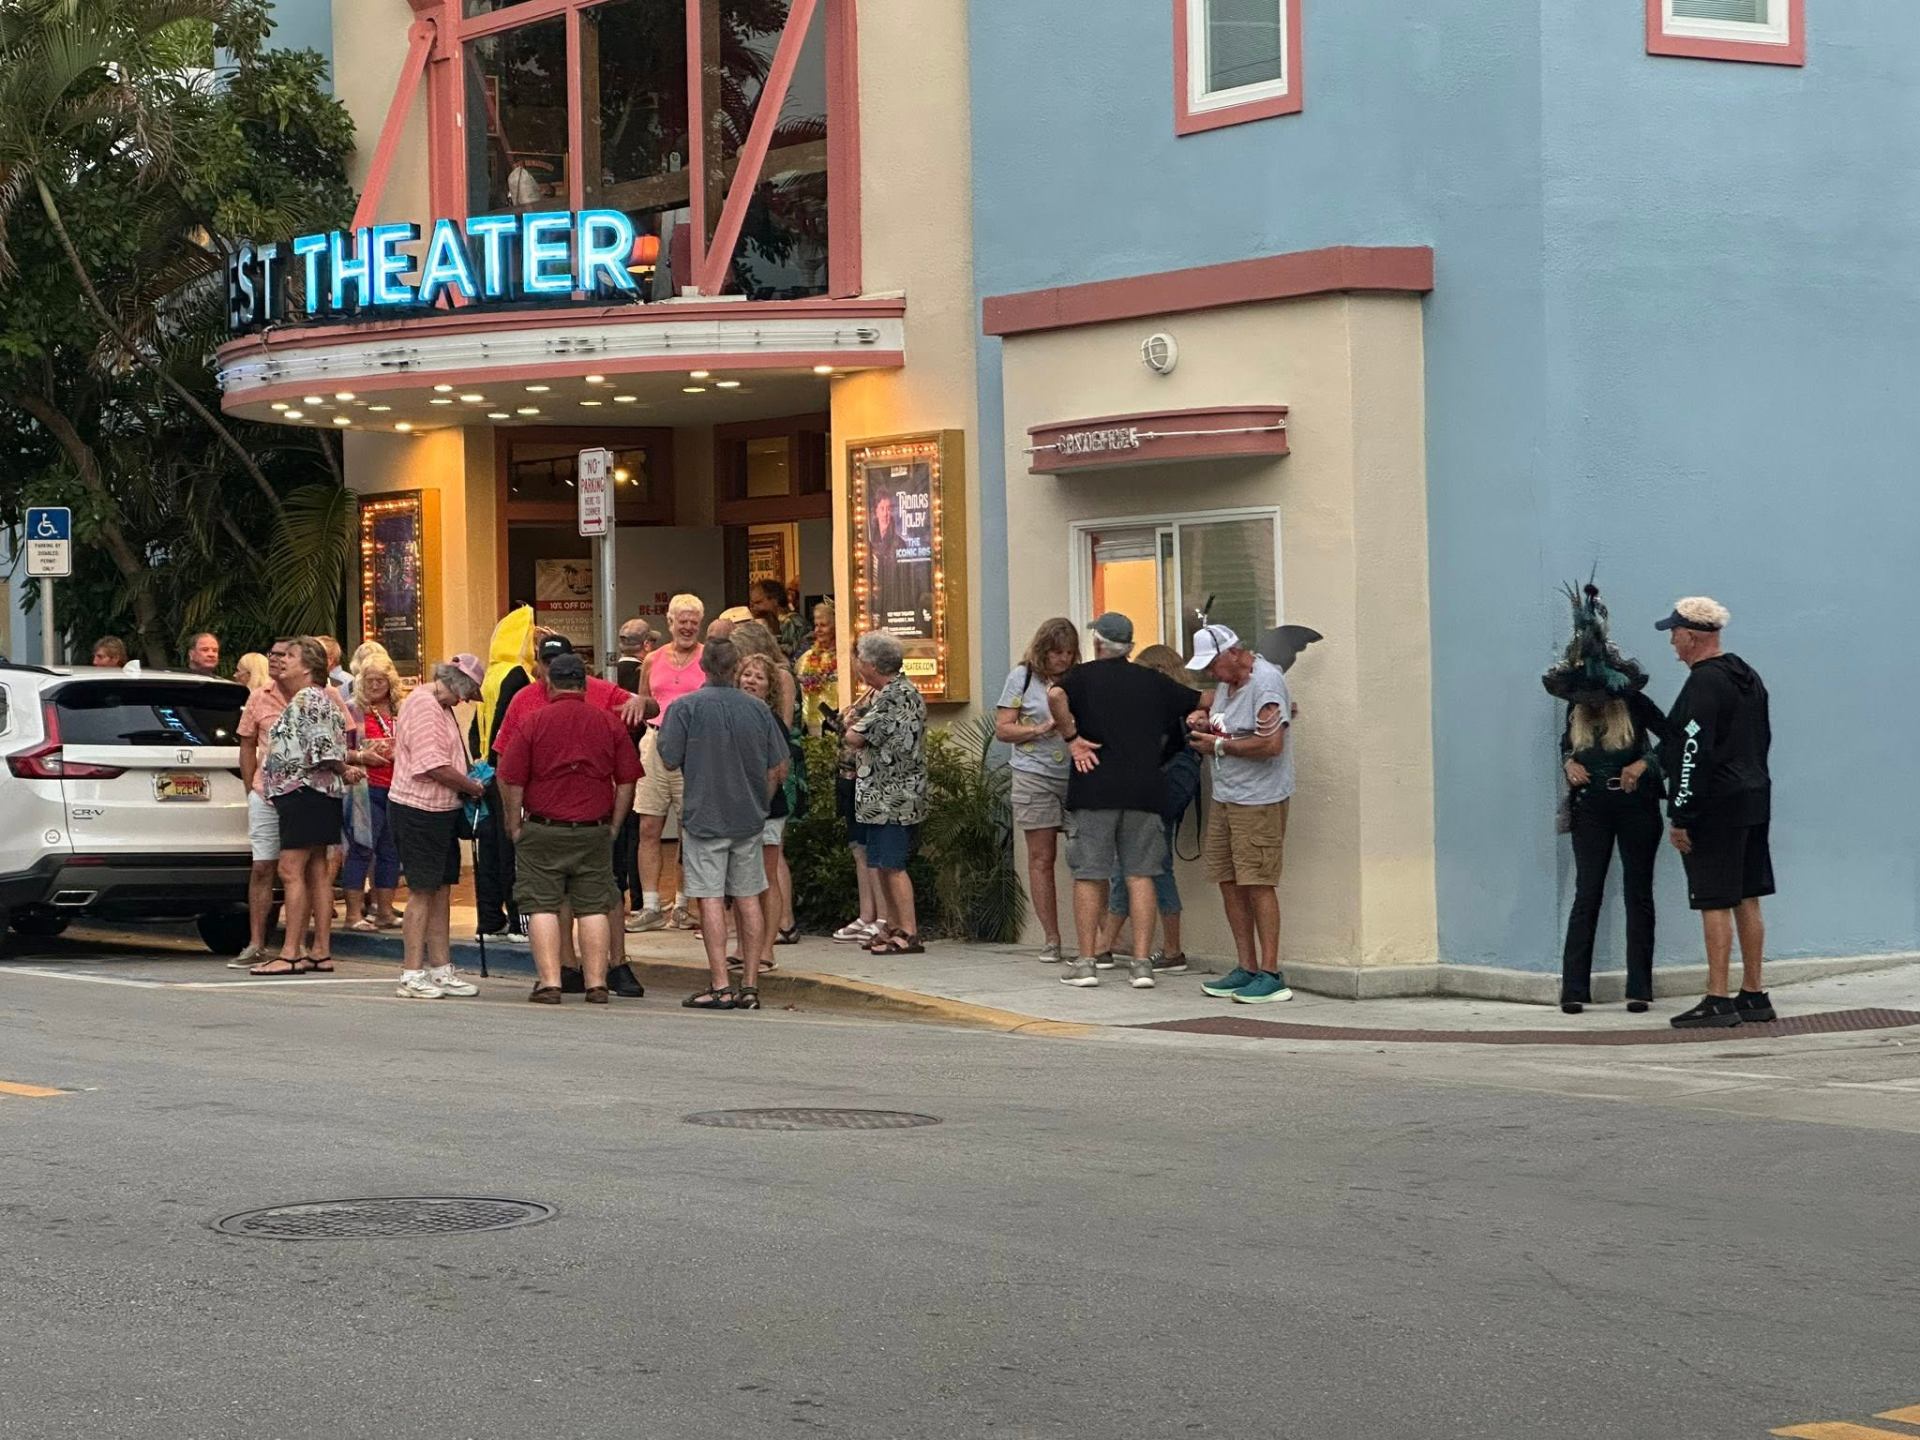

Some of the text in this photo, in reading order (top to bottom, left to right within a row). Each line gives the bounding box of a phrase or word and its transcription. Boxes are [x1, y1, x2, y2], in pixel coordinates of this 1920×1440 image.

[294, 209, 637, 313] THEATER
[587, 458, 598, 474] NO
[580, 477, 604, 493] PARKING
[896, 491, 929, 518] THOMAS
[907, 537, 921, 547] THE
[896, 547, 917, 558] ICONIC
[655, 591, 668, 603] NO
[550, 602, 562, 610] 10%
[564, 602, 578, 610] OFF
[71, 808, 105, 817] CR-V
